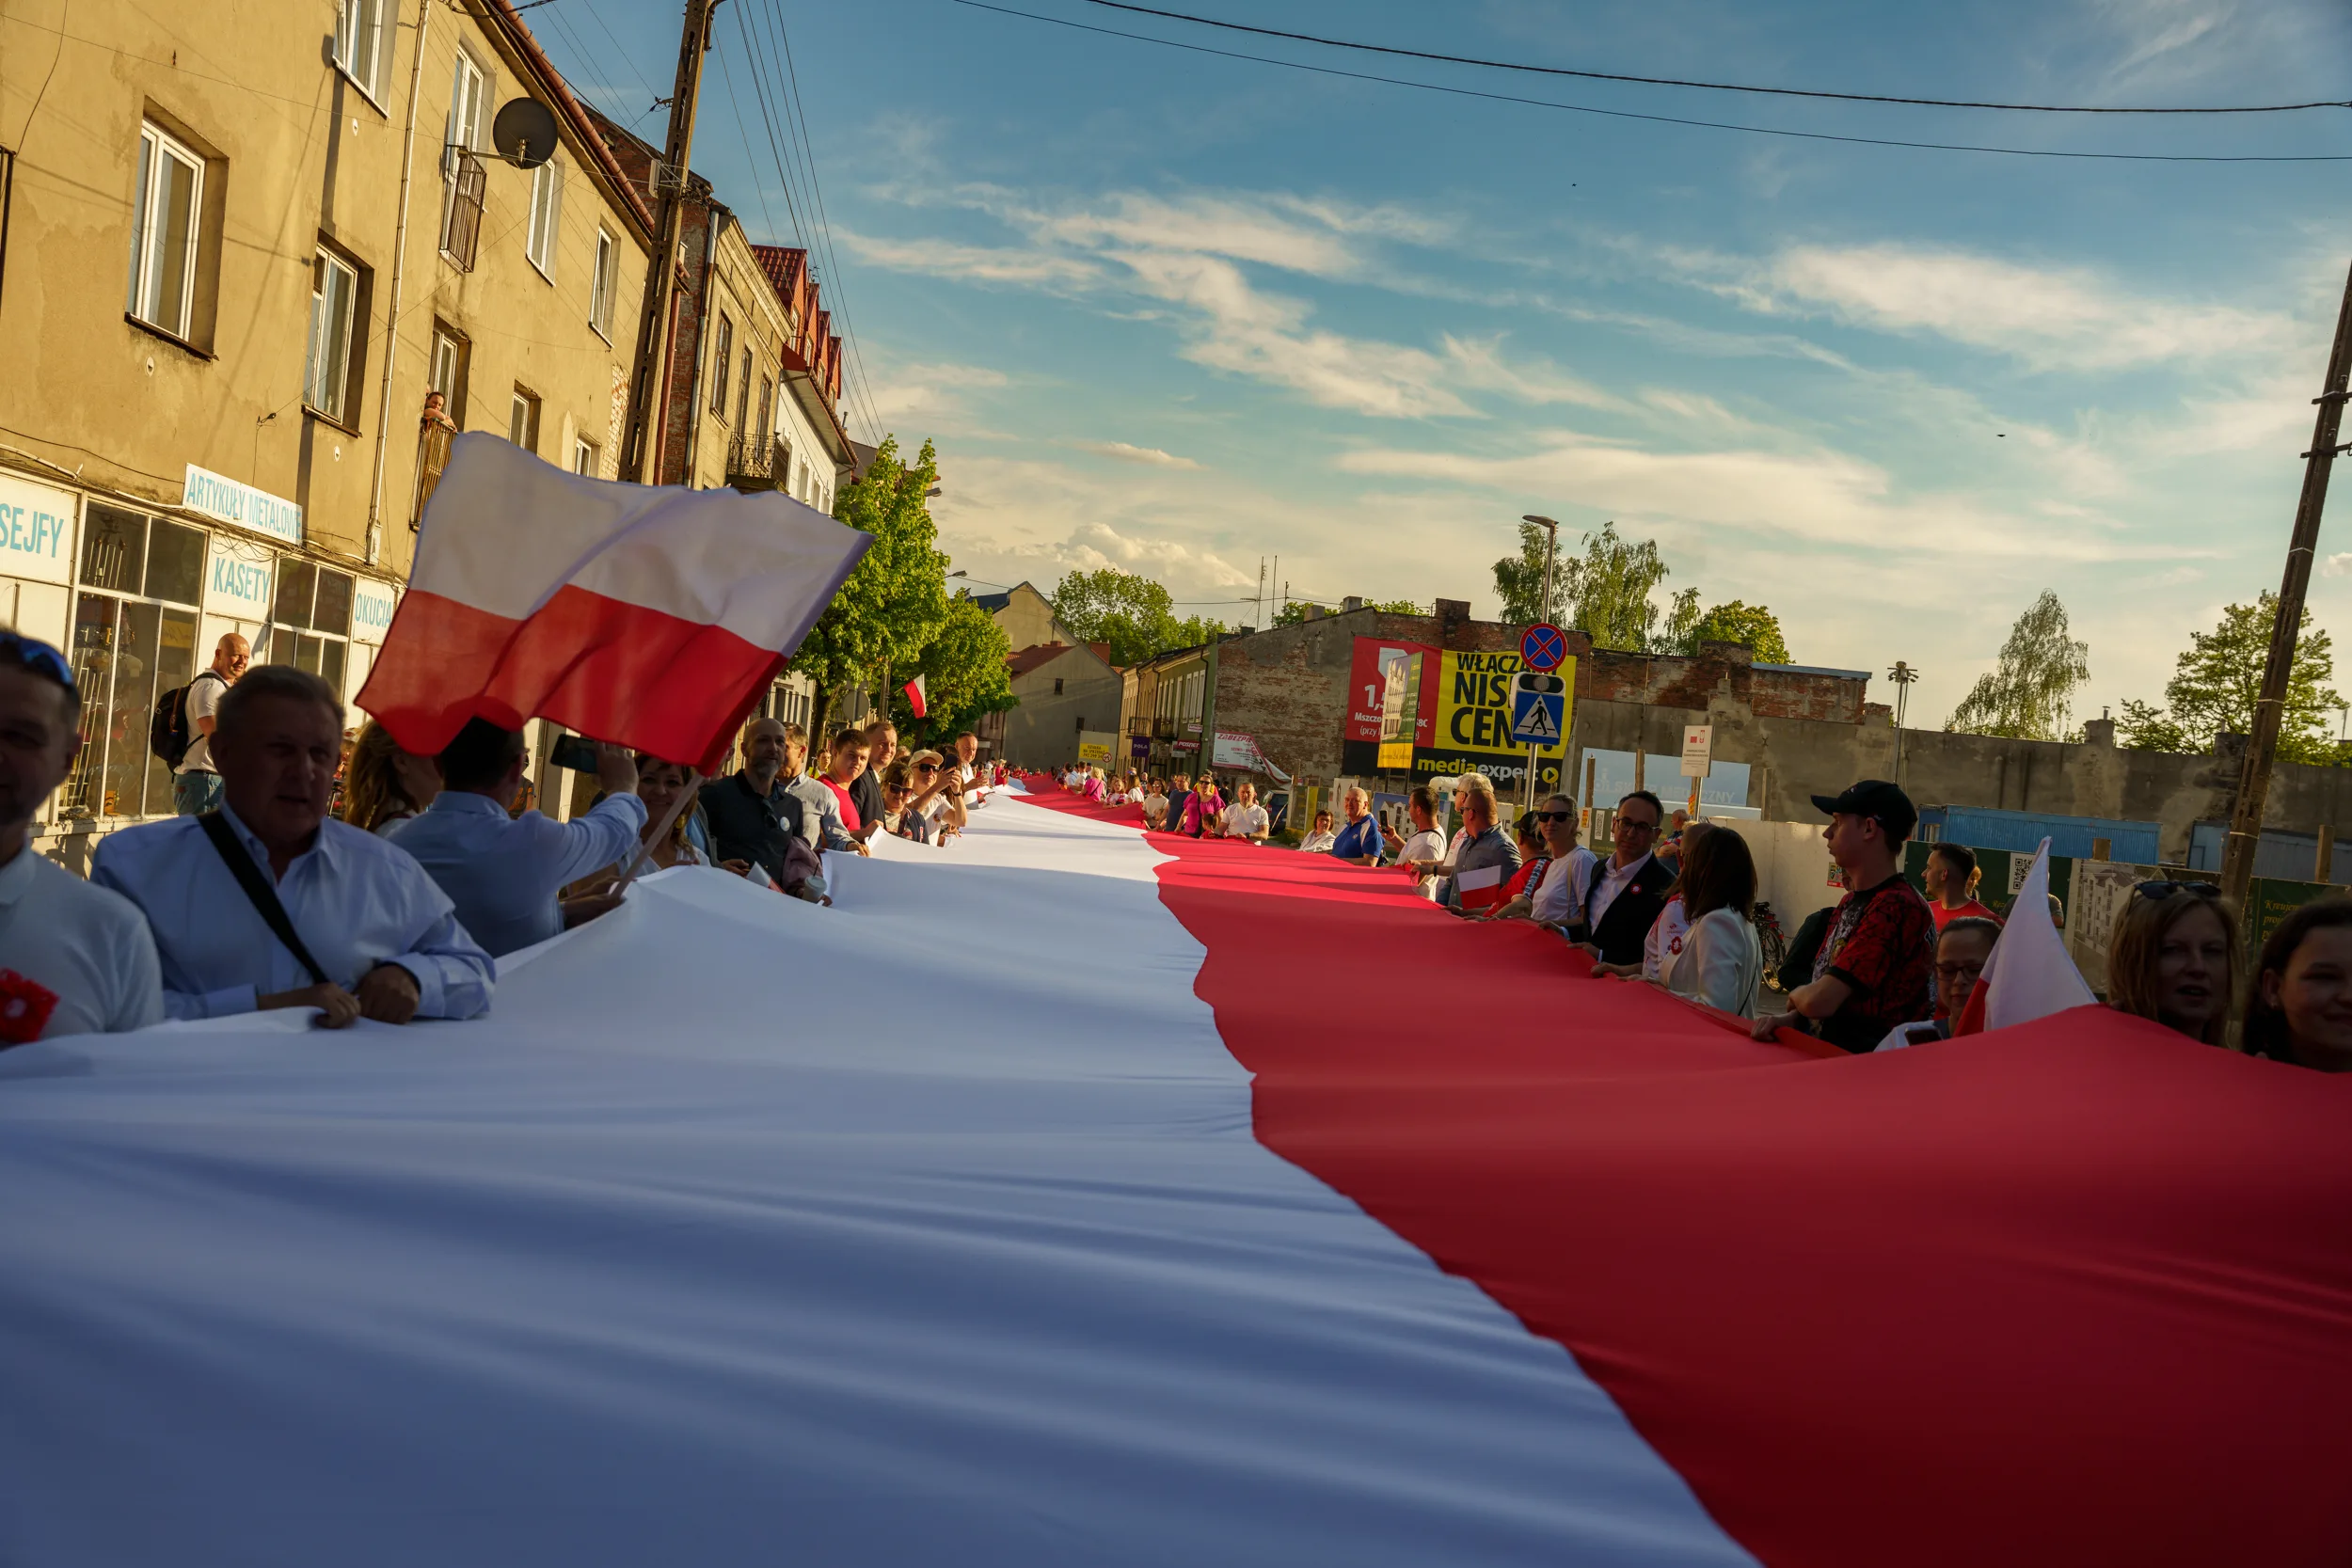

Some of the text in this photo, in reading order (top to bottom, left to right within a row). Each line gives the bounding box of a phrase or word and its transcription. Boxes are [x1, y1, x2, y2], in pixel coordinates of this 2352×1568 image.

[187, 472, 302, 539] ARTYKUŁY METALOWE
[0, 503, 64, 558] SEJFY
[213, 557, 271, 604] KASETY
[355, 593, 392, 628] OKUCIA
[1457, 653, 1557, 675] WŁĄCZA
[1355, 712, 1383, 722] Mszczo
[1661, 785, 1735, 805] MEDCZNY
